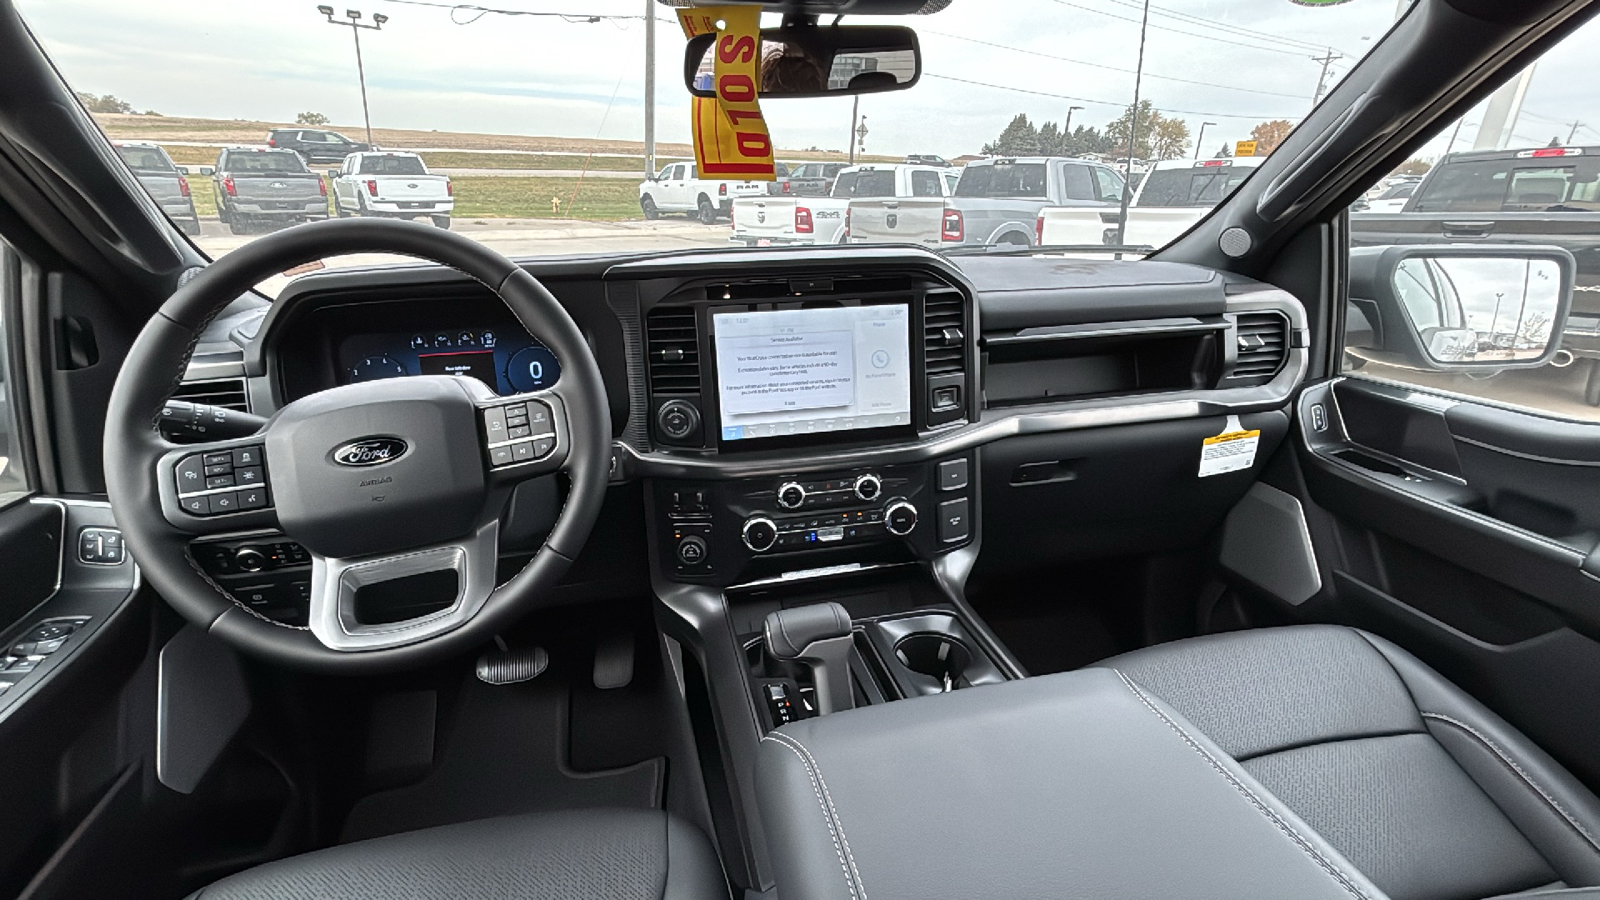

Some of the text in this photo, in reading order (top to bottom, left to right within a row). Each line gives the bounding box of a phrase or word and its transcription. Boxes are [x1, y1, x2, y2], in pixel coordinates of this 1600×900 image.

[719, 35, 771, 157] SOLD
[529, 361, 543, 379] 0
[349, 443, 392, 462] Ford
